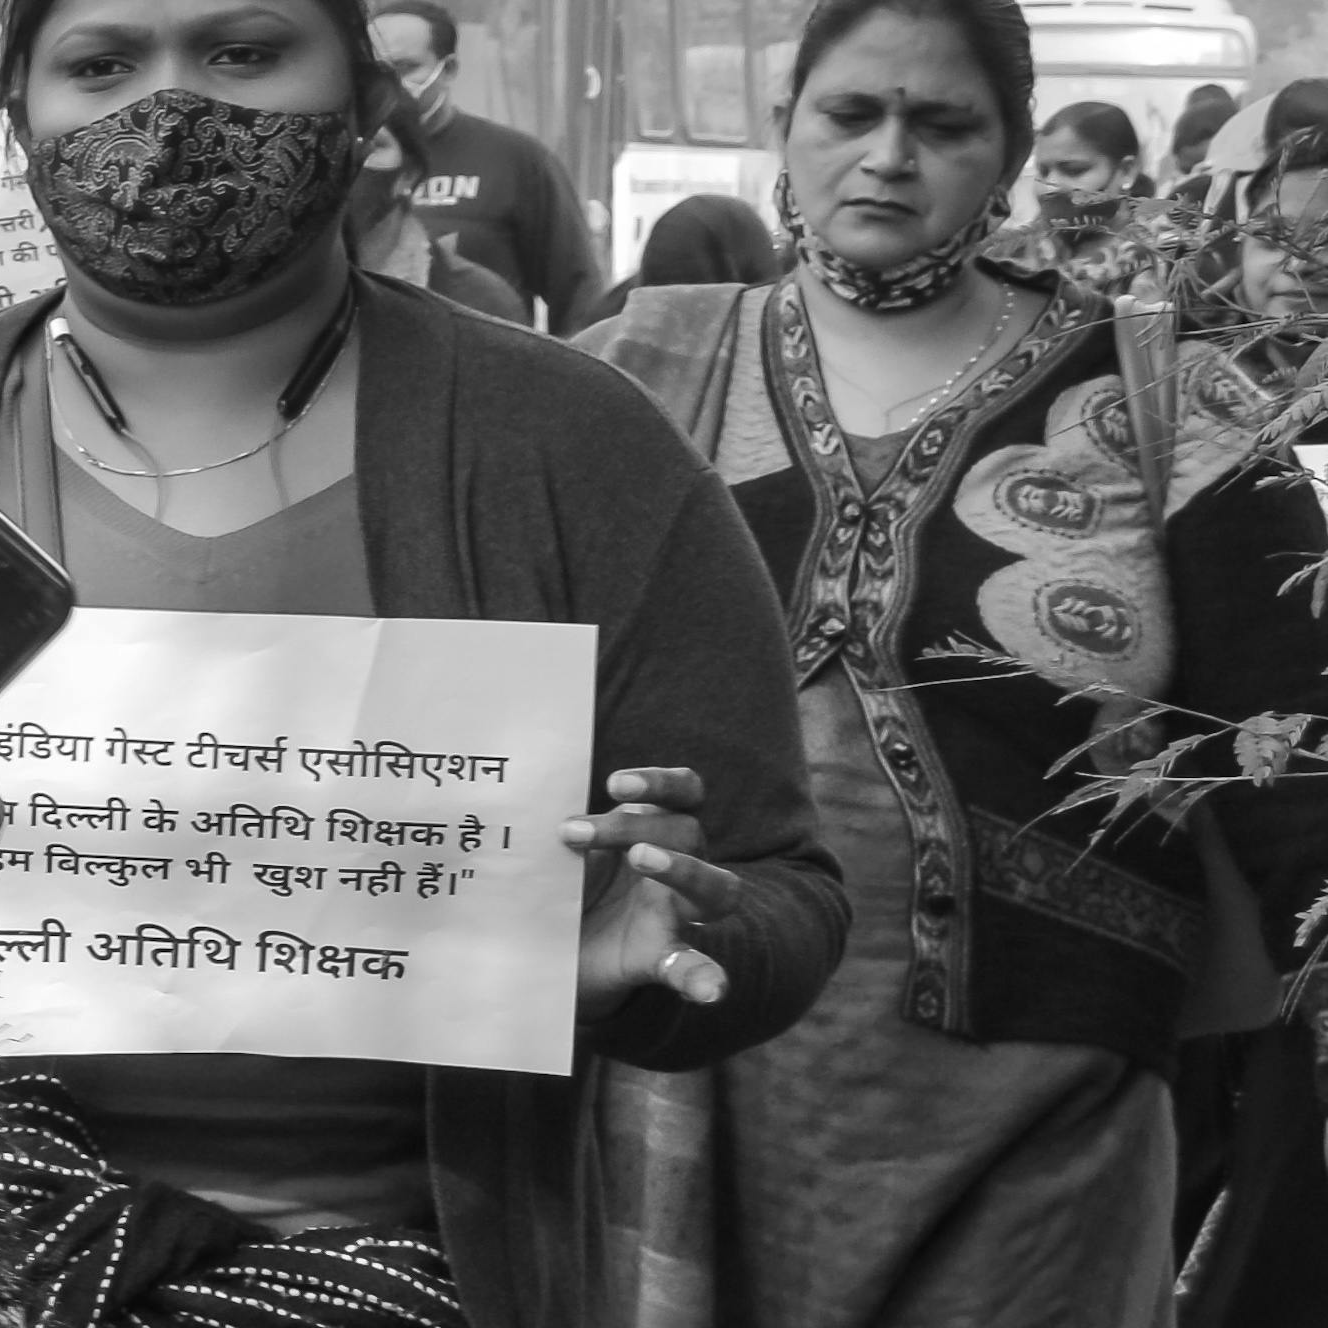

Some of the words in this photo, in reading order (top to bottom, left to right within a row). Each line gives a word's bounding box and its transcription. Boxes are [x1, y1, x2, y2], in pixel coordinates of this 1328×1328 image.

[10, 241, 39, 262] की
[105, 727, 175, 766] गेस्ट
[186, 733, 289, 773] टीचर्स
[298, 739, 510, 787] एसोसिएशन
[27, 792, 132, 830] दिल्ली
[142, 798, 181, 833] के
[190, 804, 316, 842] अतिथि
[325, 808, 448, 847] शिक्षक
[458, 814, 487, 852] है
[185, 852, 231, 884] भी
[253, 863, 328, 897] खुश
[85, 923, 243, 972] अतिथि
[255, 930, 410, 982] शिक्षक
